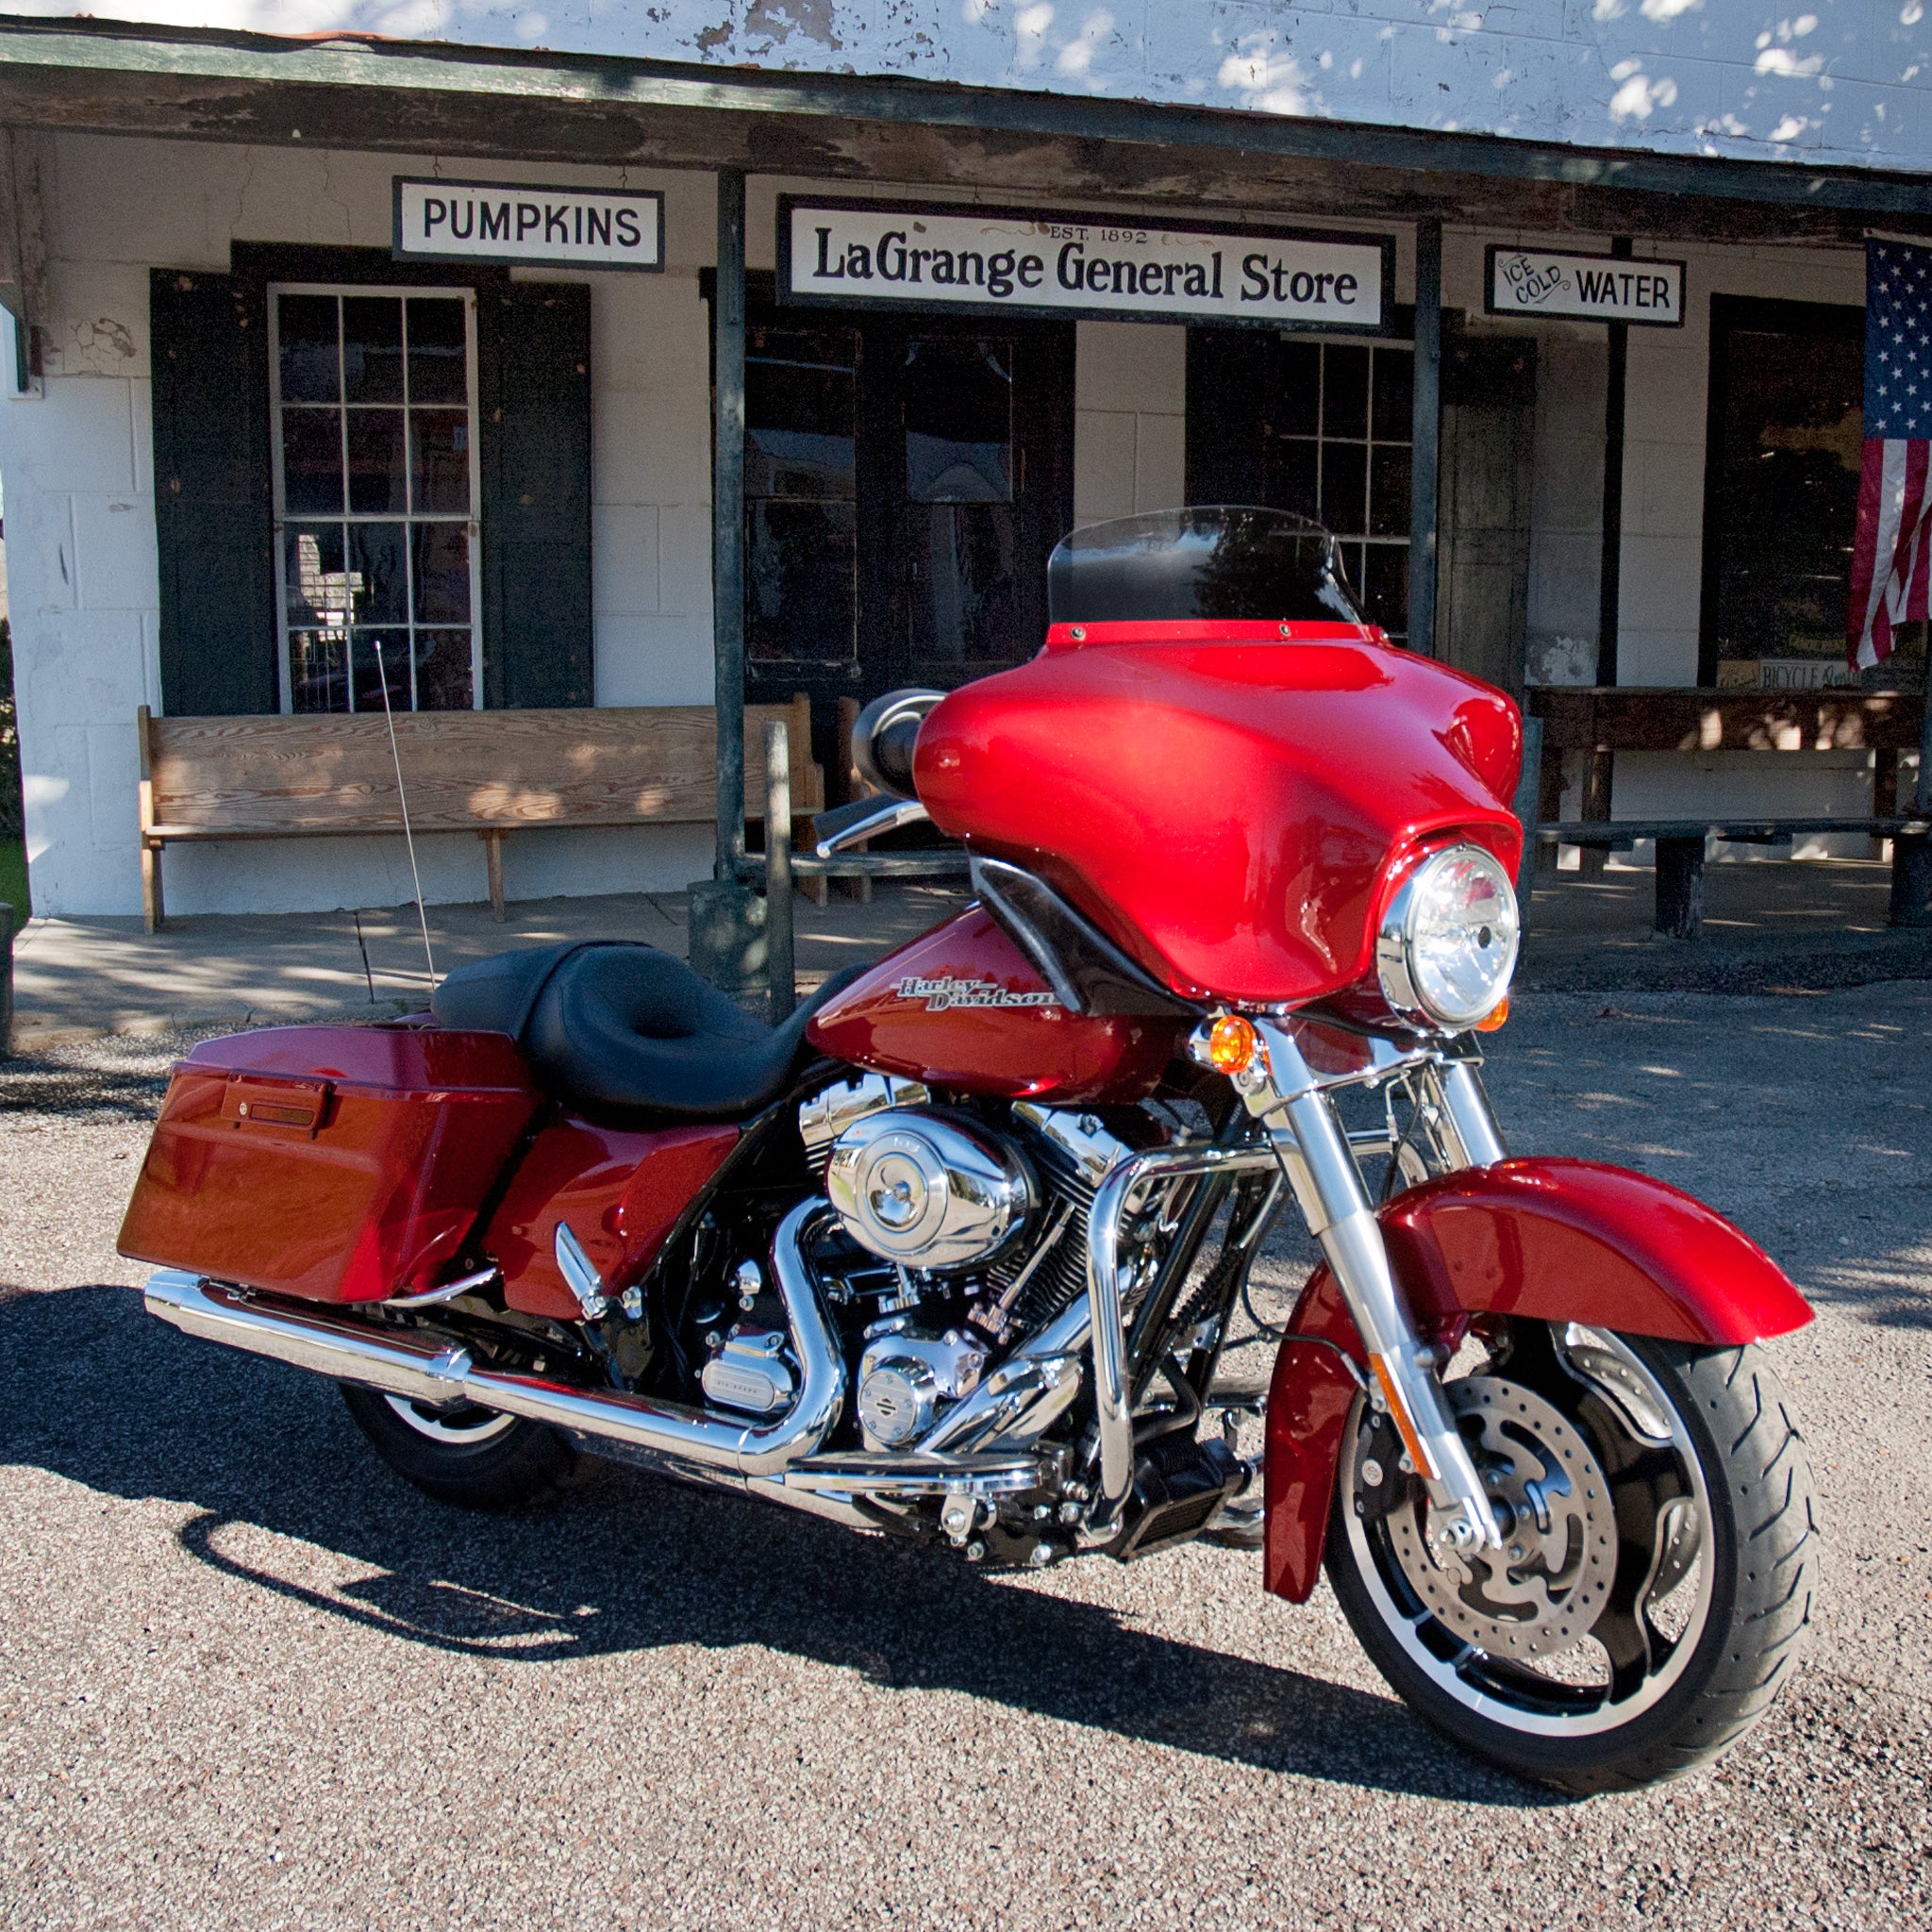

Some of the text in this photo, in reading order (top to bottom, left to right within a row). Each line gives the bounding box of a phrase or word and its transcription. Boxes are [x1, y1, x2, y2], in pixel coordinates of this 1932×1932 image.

[424, 197, 641, 247] PUMPKINS
[1100, 229, 1148, 244] 1892
[812, 226, 1358, 305] LaGrange General Store
[1503, 258, 1535, 287] ICE
[1516, 265, 1561, 304] COLD
[1575, 270, 1670, 309] WATER
[1763, 666, 1820, 688] BICYCLE
[898, 977, 982, 996] Harley
